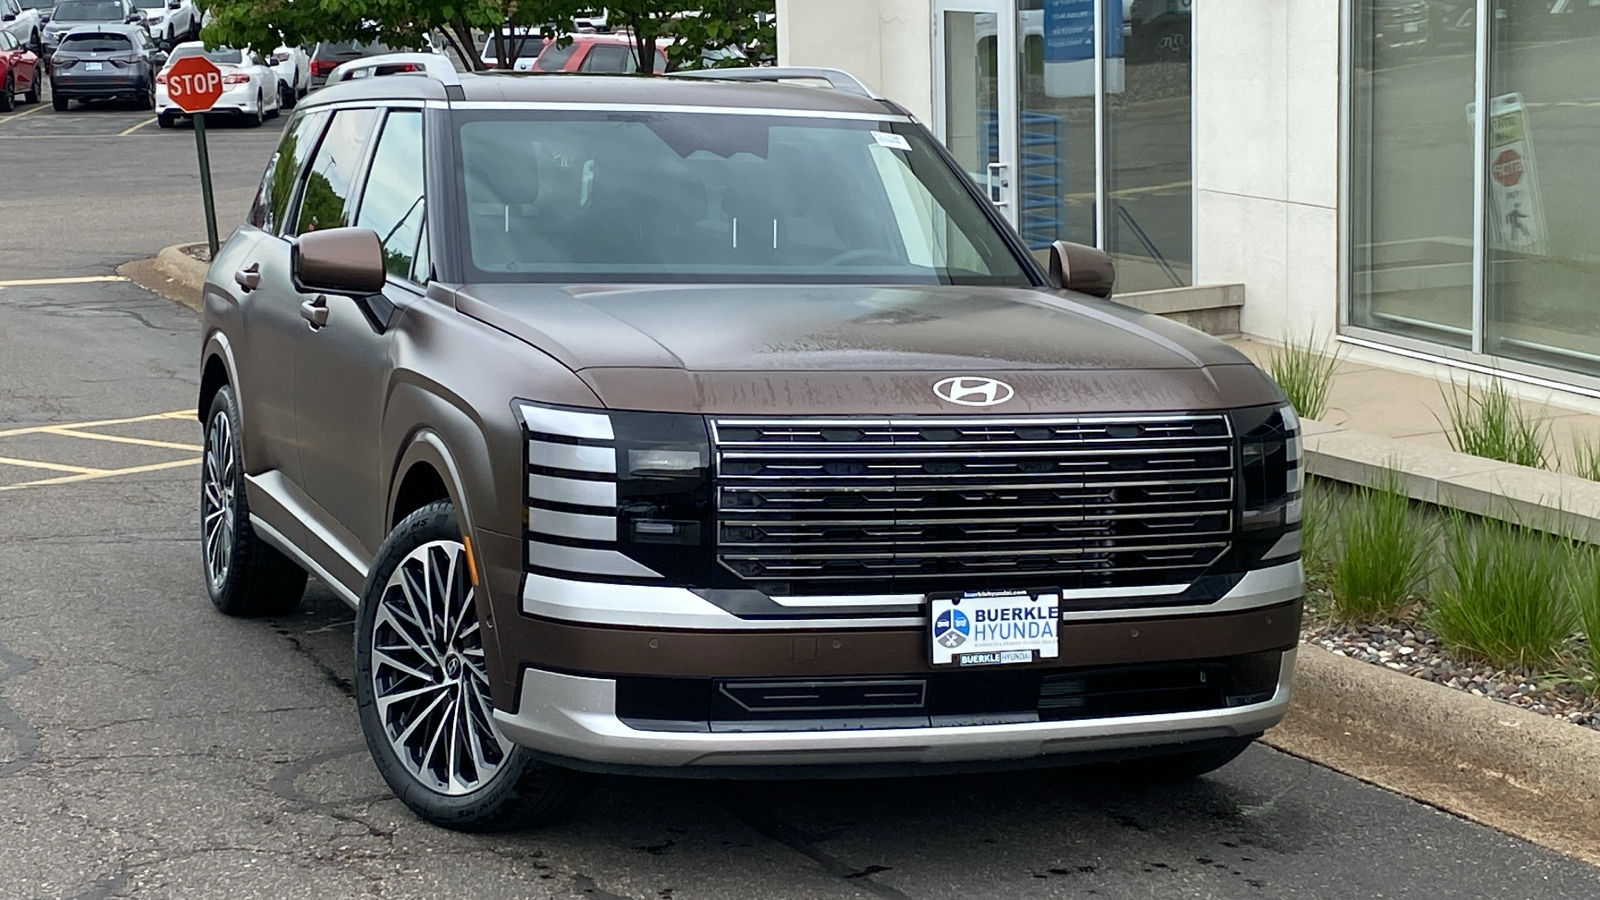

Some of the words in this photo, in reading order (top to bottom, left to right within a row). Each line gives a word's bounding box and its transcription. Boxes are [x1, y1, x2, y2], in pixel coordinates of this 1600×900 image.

[169, 72, 219, 96] STOP
[975, 606, 1058, 622] BUERKLE
[961, 654, 1000, 664] BUERKLE
[1001, 653, 1030, 662] HYUNDAI
